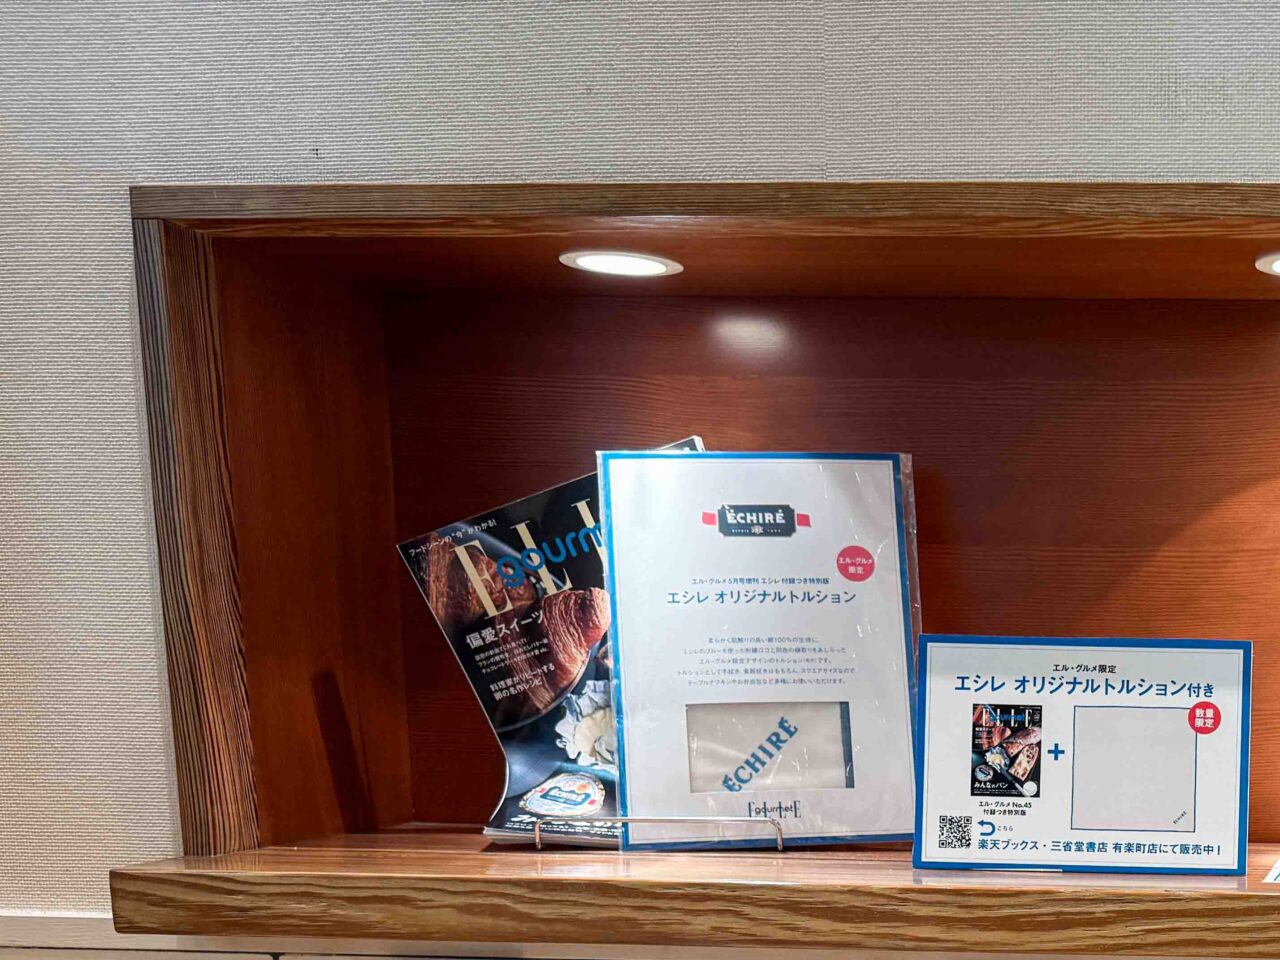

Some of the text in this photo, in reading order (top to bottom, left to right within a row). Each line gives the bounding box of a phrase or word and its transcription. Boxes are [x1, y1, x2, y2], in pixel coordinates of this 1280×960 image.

[667, 589, 859, 606] エシレ オリジナルトルション
[1052, 662, 1117, 675] エル・グルメ限定
[954, 673, 1215, 698] エシレ オリジナルトルション付き
[1194, 706, 1215, 719] 数量
[1194, 717, 1215, 730] 限定
[978, 801, 1010, 809] エル・グルメ
[996, 824, 1014, 832] こちら
[977, 838, 1221, 857] 楽天ブックス・三省堂書店 有楽町店にて販売中!
